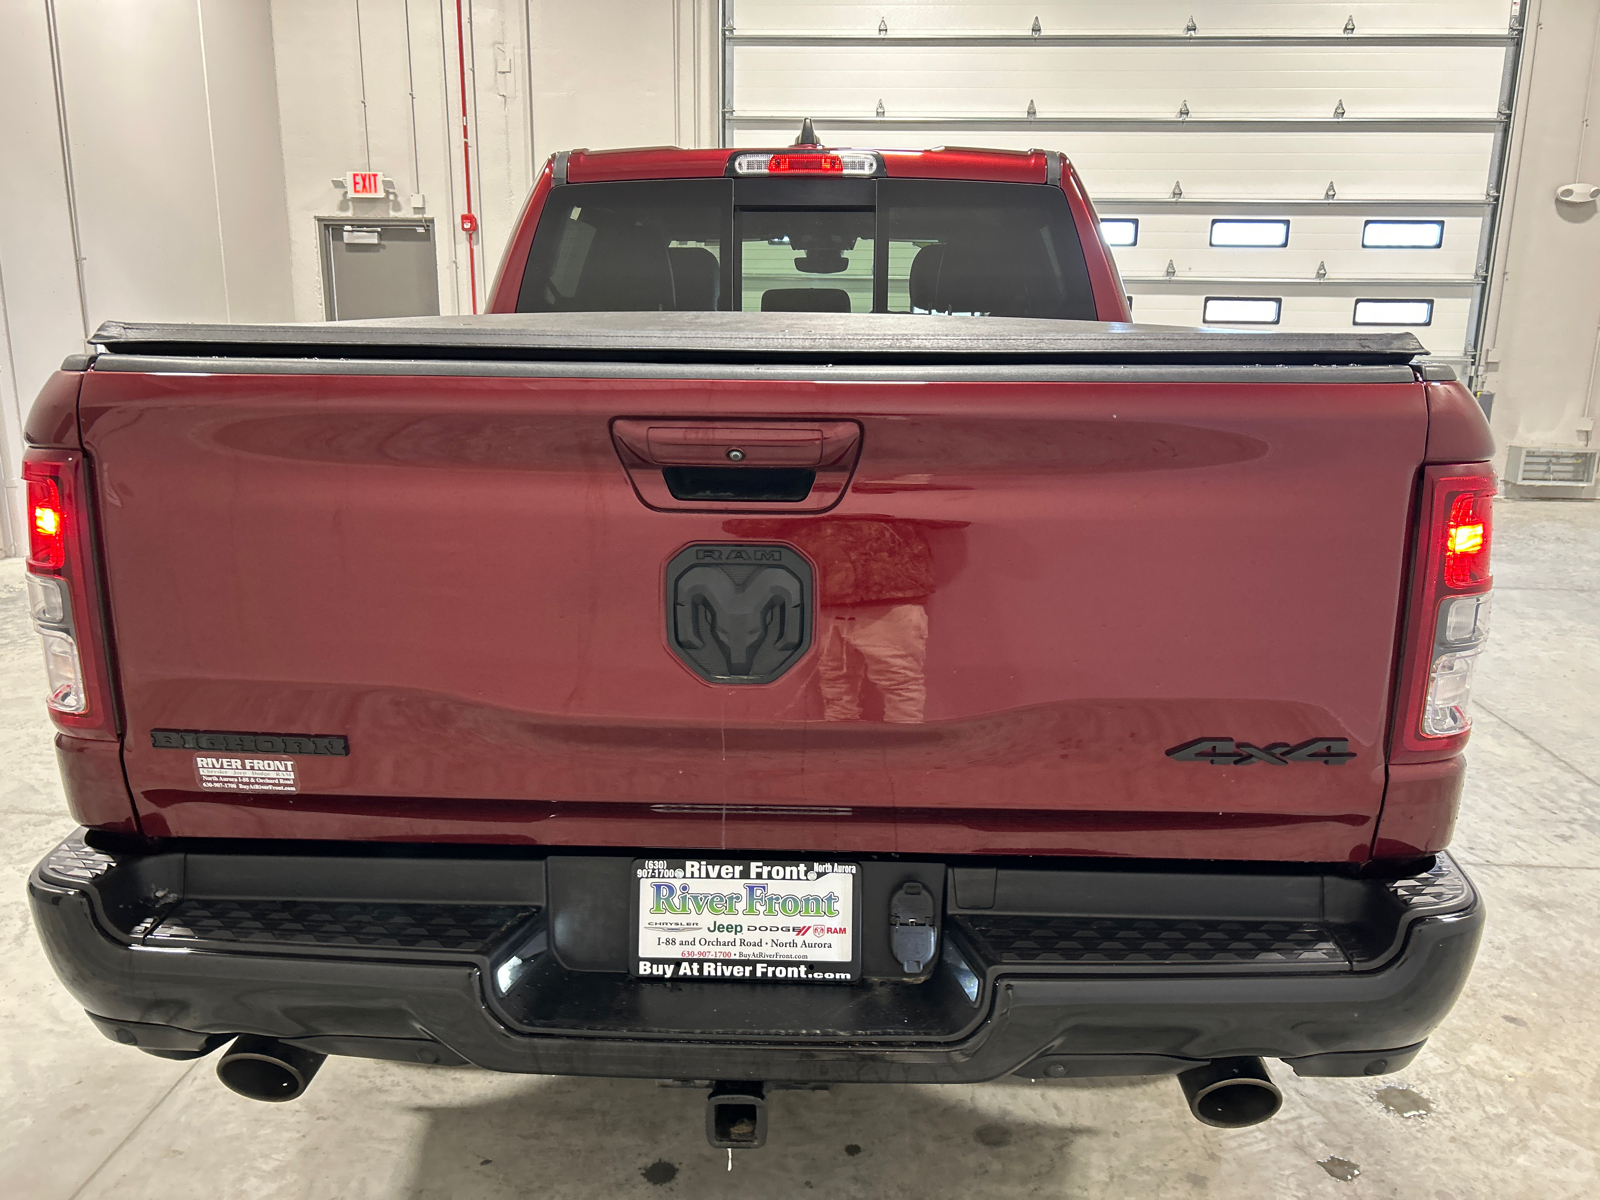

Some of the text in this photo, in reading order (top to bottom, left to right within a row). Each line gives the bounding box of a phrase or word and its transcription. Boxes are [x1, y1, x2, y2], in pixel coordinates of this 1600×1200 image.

[352, 173, 378, 194] EXIT
[695, 549, 782, 561] RAM
[150, 728, 350, 757] BIGHORN
[196, 757, 294, 772] RIVER FRONT
[645, 860, 667, 870] (630)
[685, 861, 807, 880] River Front
[813, 862, 856, 874] North Aurora
[637, 868, 674, 878] 907-1700
[650, 882, 840, 917] River Front
[707, 920, 744, 936] Jeep
[747, 925, 802, 933] DODGE
[826, 927, 847, 935] RAM
[657, 937, 833, 949] I-88 and Orchard Road North Aurora
[681, 950, 809, 960] 630-907-1700 BuyAtRiverFront.com
[639, 961, 851, 980] Buy At River Front.com
